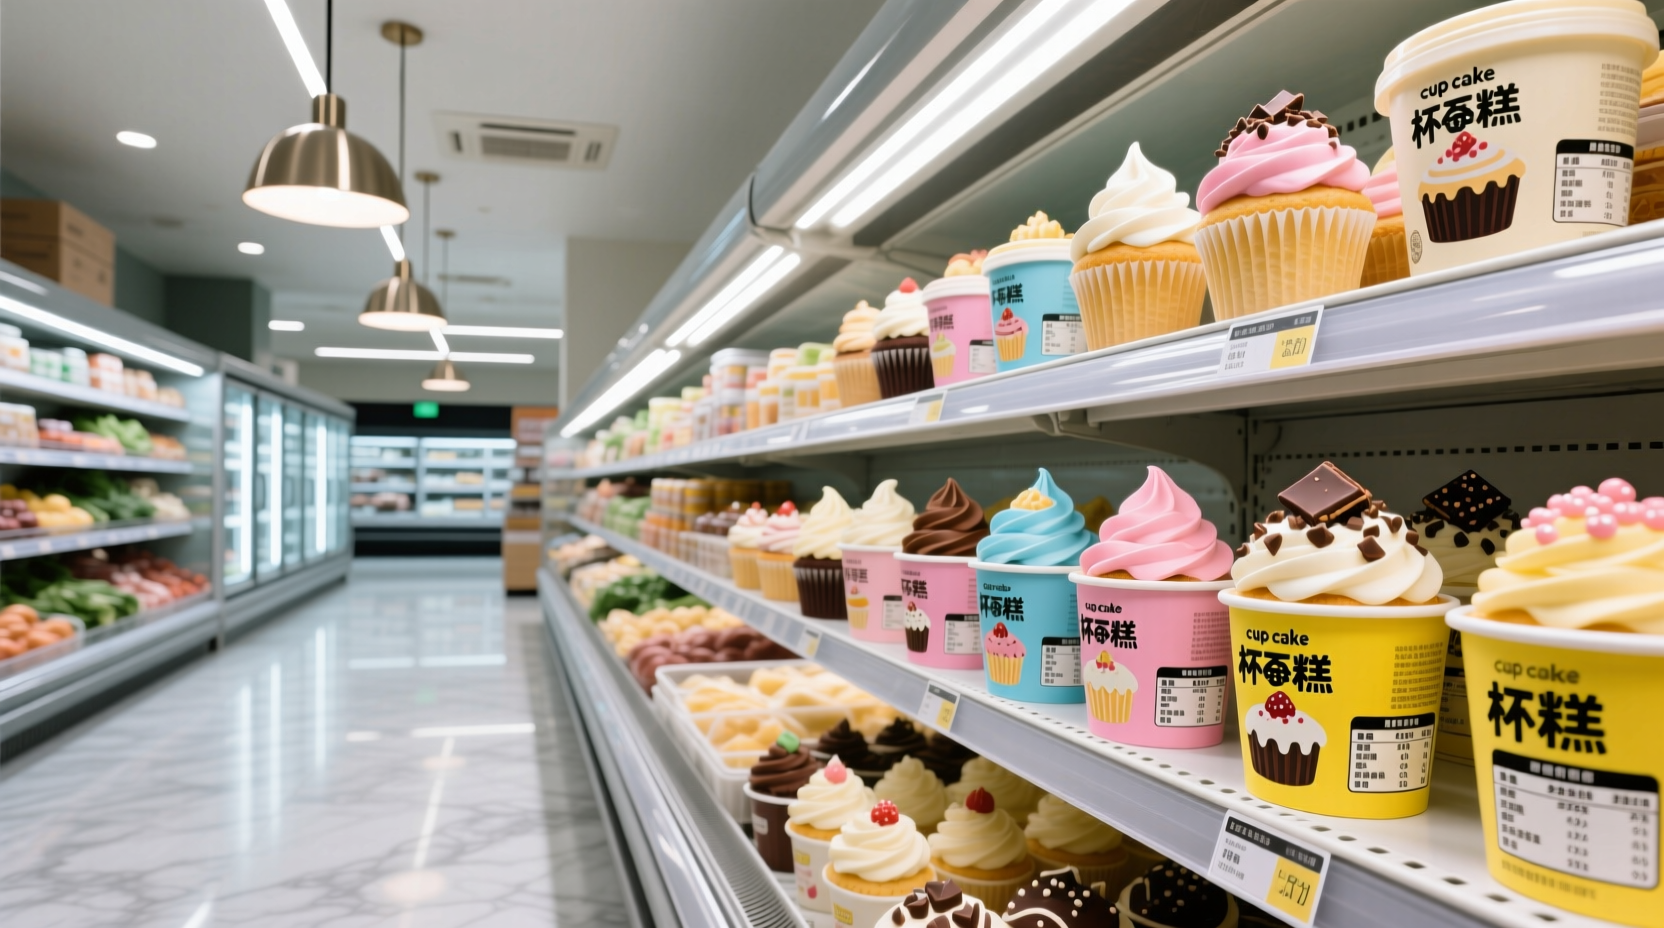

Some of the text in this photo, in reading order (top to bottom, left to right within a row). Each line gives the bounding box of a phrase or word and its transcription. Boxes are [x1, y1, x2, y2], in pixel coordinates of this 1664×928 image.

[1420, 66, 1495, 99] cup cake
[1246, 628, 1309, 646] cup cake
[1494, 660, 1580, 684] cup cake
[1487, 681, 1607, 755] 杯糕
